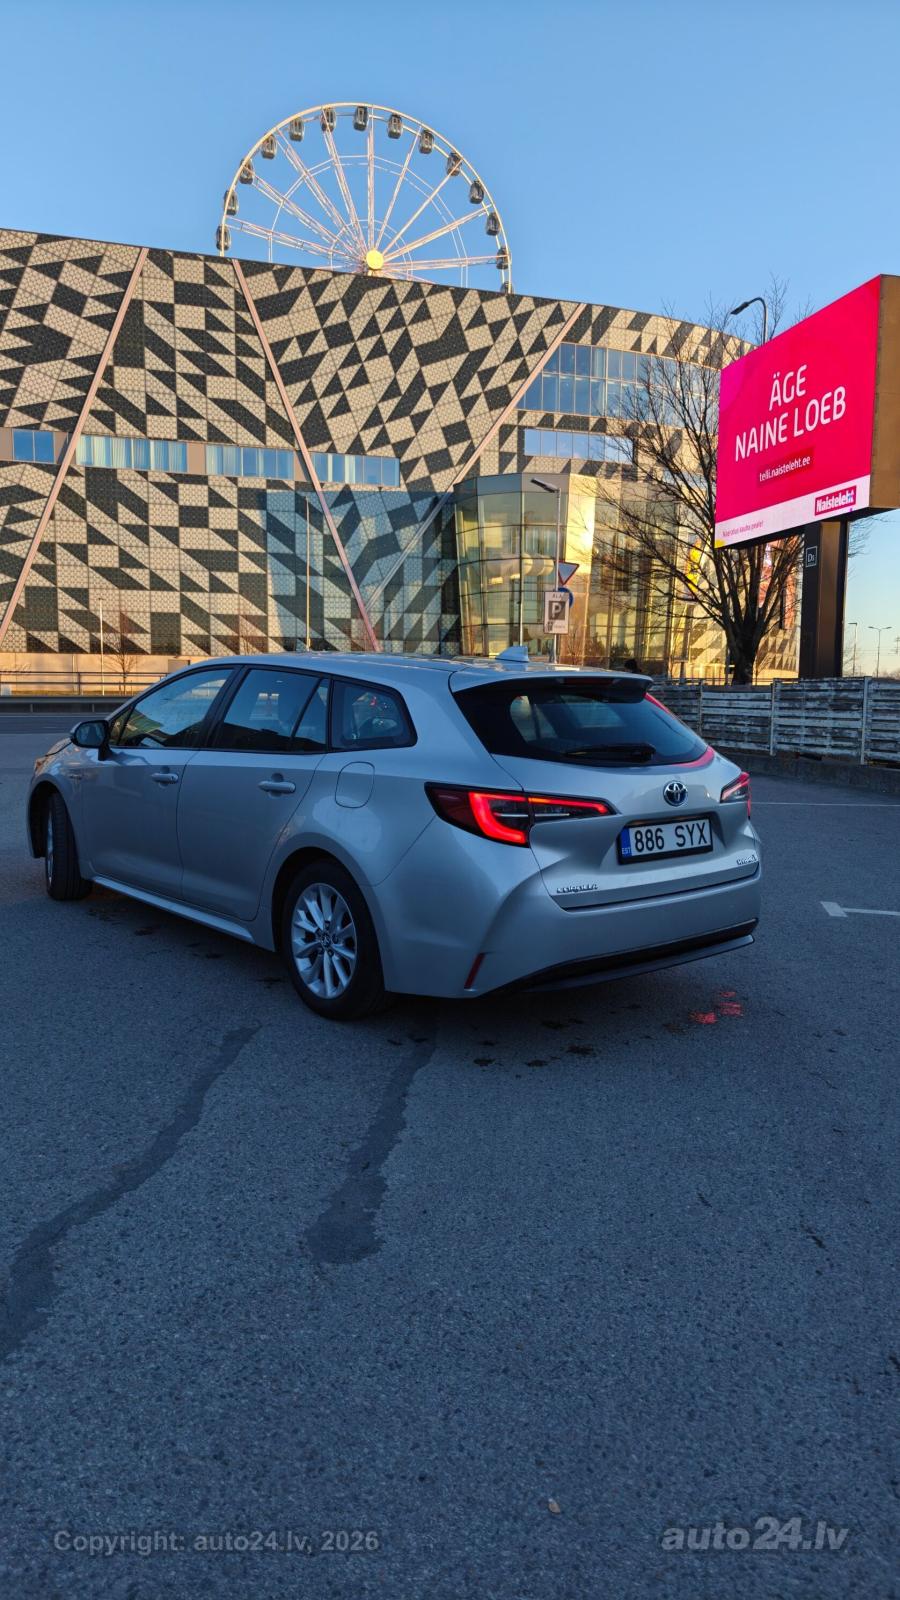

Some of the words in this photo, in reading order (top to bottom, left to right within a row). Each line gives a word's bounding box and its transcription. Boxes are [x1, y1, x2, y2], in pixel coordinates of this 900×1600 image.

[769, 364, 807, 411] ÄGE
[735, 412, 788, 462] NAINE
[793, 386, 846, 437] LOEB
[759, 456, 811, 482] telli.naisteleht.ee
[551, 602, 562, 618] P
[621, 846, 631, 855] EST
[634, 828, 665, 853] 886
[674, 822, 708, 848] SYX
